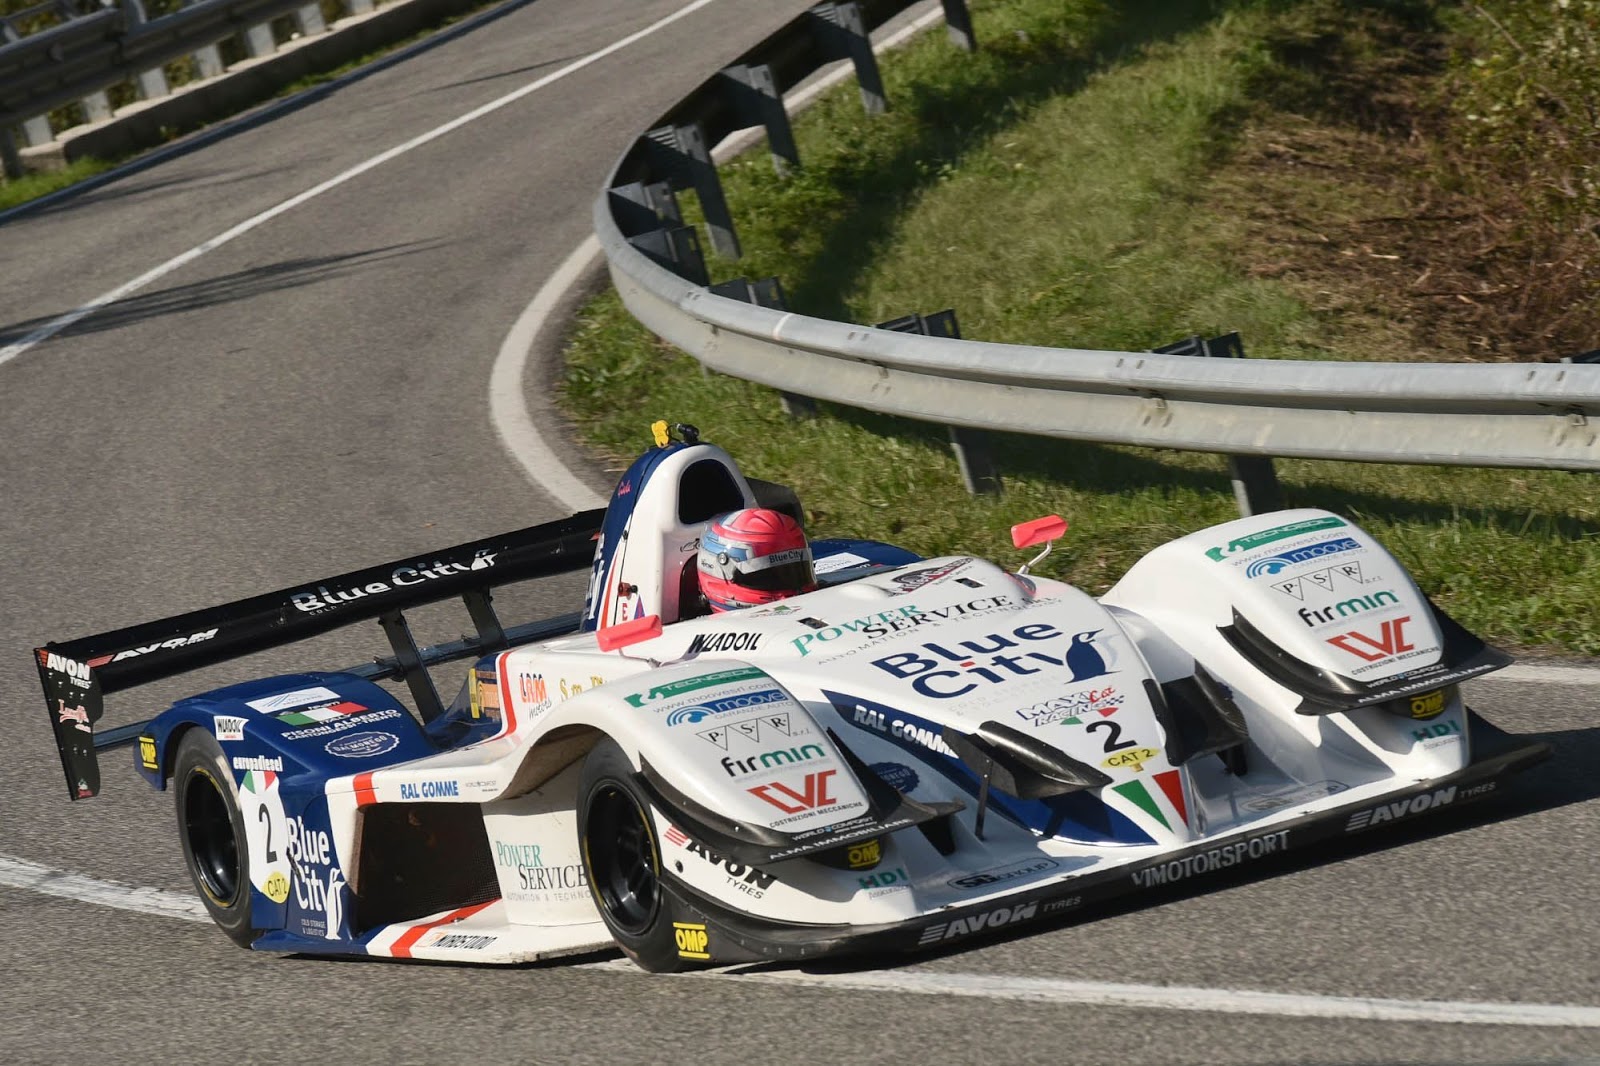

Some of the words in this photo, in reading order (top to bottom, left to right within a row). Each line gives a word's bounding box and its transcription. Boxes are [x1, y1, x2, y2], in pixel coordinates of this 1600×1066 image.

[768, 553, 788, 564] Blue
[788, 550, 804, 561] City
[1292, 538, 1361, 562] moove
[290, 585, 392, 612] Blue
[1298, 590, 1399, 627] firmin
[789, 604, 924, 657] POWER
[862, 595, 1013, 639] SERVICE
[112, 628, 219, 662] AVON
[818, 628, 919, 665] AUTOMATION
[869, 623, 1063, 680] Blue
[1326, 616, 1415, 662] CVC
[46, 653, 91, 681] AVON
[70, 676, 91, 690] TYRES
[715, 690, 787, 712] moove
[281, 724, 332, 738] PISONI
[334, 709, 398, 729] ALBERTO
[854, 704, 887, 732] RAL
[892, 719, 959, 759] GOMM
[1086, 720, 1138, 753] 2
[1411, 720, 1460, 742] HDI
[140, 742, 157, 763] OMP
[721, 744, 826, 777] firmin
[1107, 751, 1140, 767] CAT
[1141, 748, 1154, 758] 2
[400, 783, 420, 799] RAL
[421, 780, 459, 798] GOMME
[746, 769, 837, 815] CVC
[1369, 786, 1457, 826] AVON
[1459, 781, 1496, 799] TYRES
[769, 810, 816, 828] COSTRUZIONI
[818, 801, 864, 815] MECCANICHE
[259, 803, 277, 864] 2
[285, 815, 331, 866] Blue
[792, 828, 824, 840] WORLD
[496, 840, 543, 868] POWER
[685, 839, 778, 890] AVON
[769, 845, 813, 860] ALMA
[518, 863, 588, 890] SERVICE
[726, 877, 764, 899] TYRES
[858, 867, 908, 890] HDI
[554, 889, 592, 902] TECHNO
[945, 900, 1039, 939] AVON
[1043, 896, 1082, 912] TYRES
[675, 929, 708, 953] OMP
